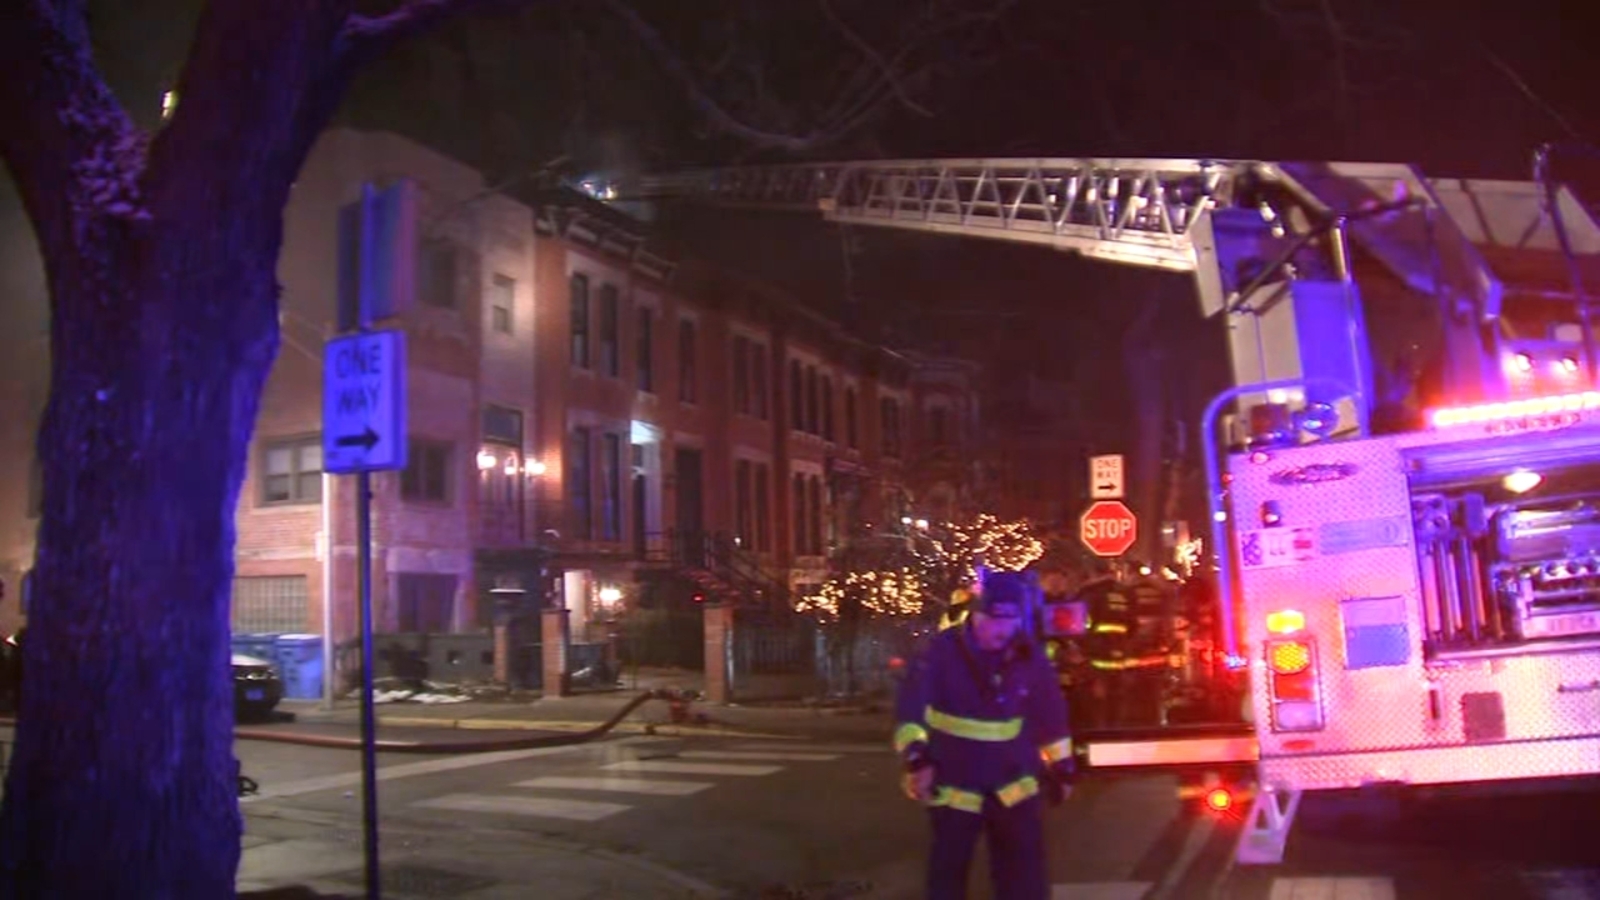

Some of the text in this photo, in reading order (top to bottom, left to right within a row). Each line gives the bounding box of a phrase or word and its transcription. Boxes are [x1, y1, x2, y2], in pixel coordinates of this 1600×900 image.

[335, 343, 381, 378] ONE
[337, 381, 381, 415] WAY
[1097, 459, 1118, 469] ONE
[1097, 471, 1118, 479] WAY
[1085, 519, 1131, 539] STOP
